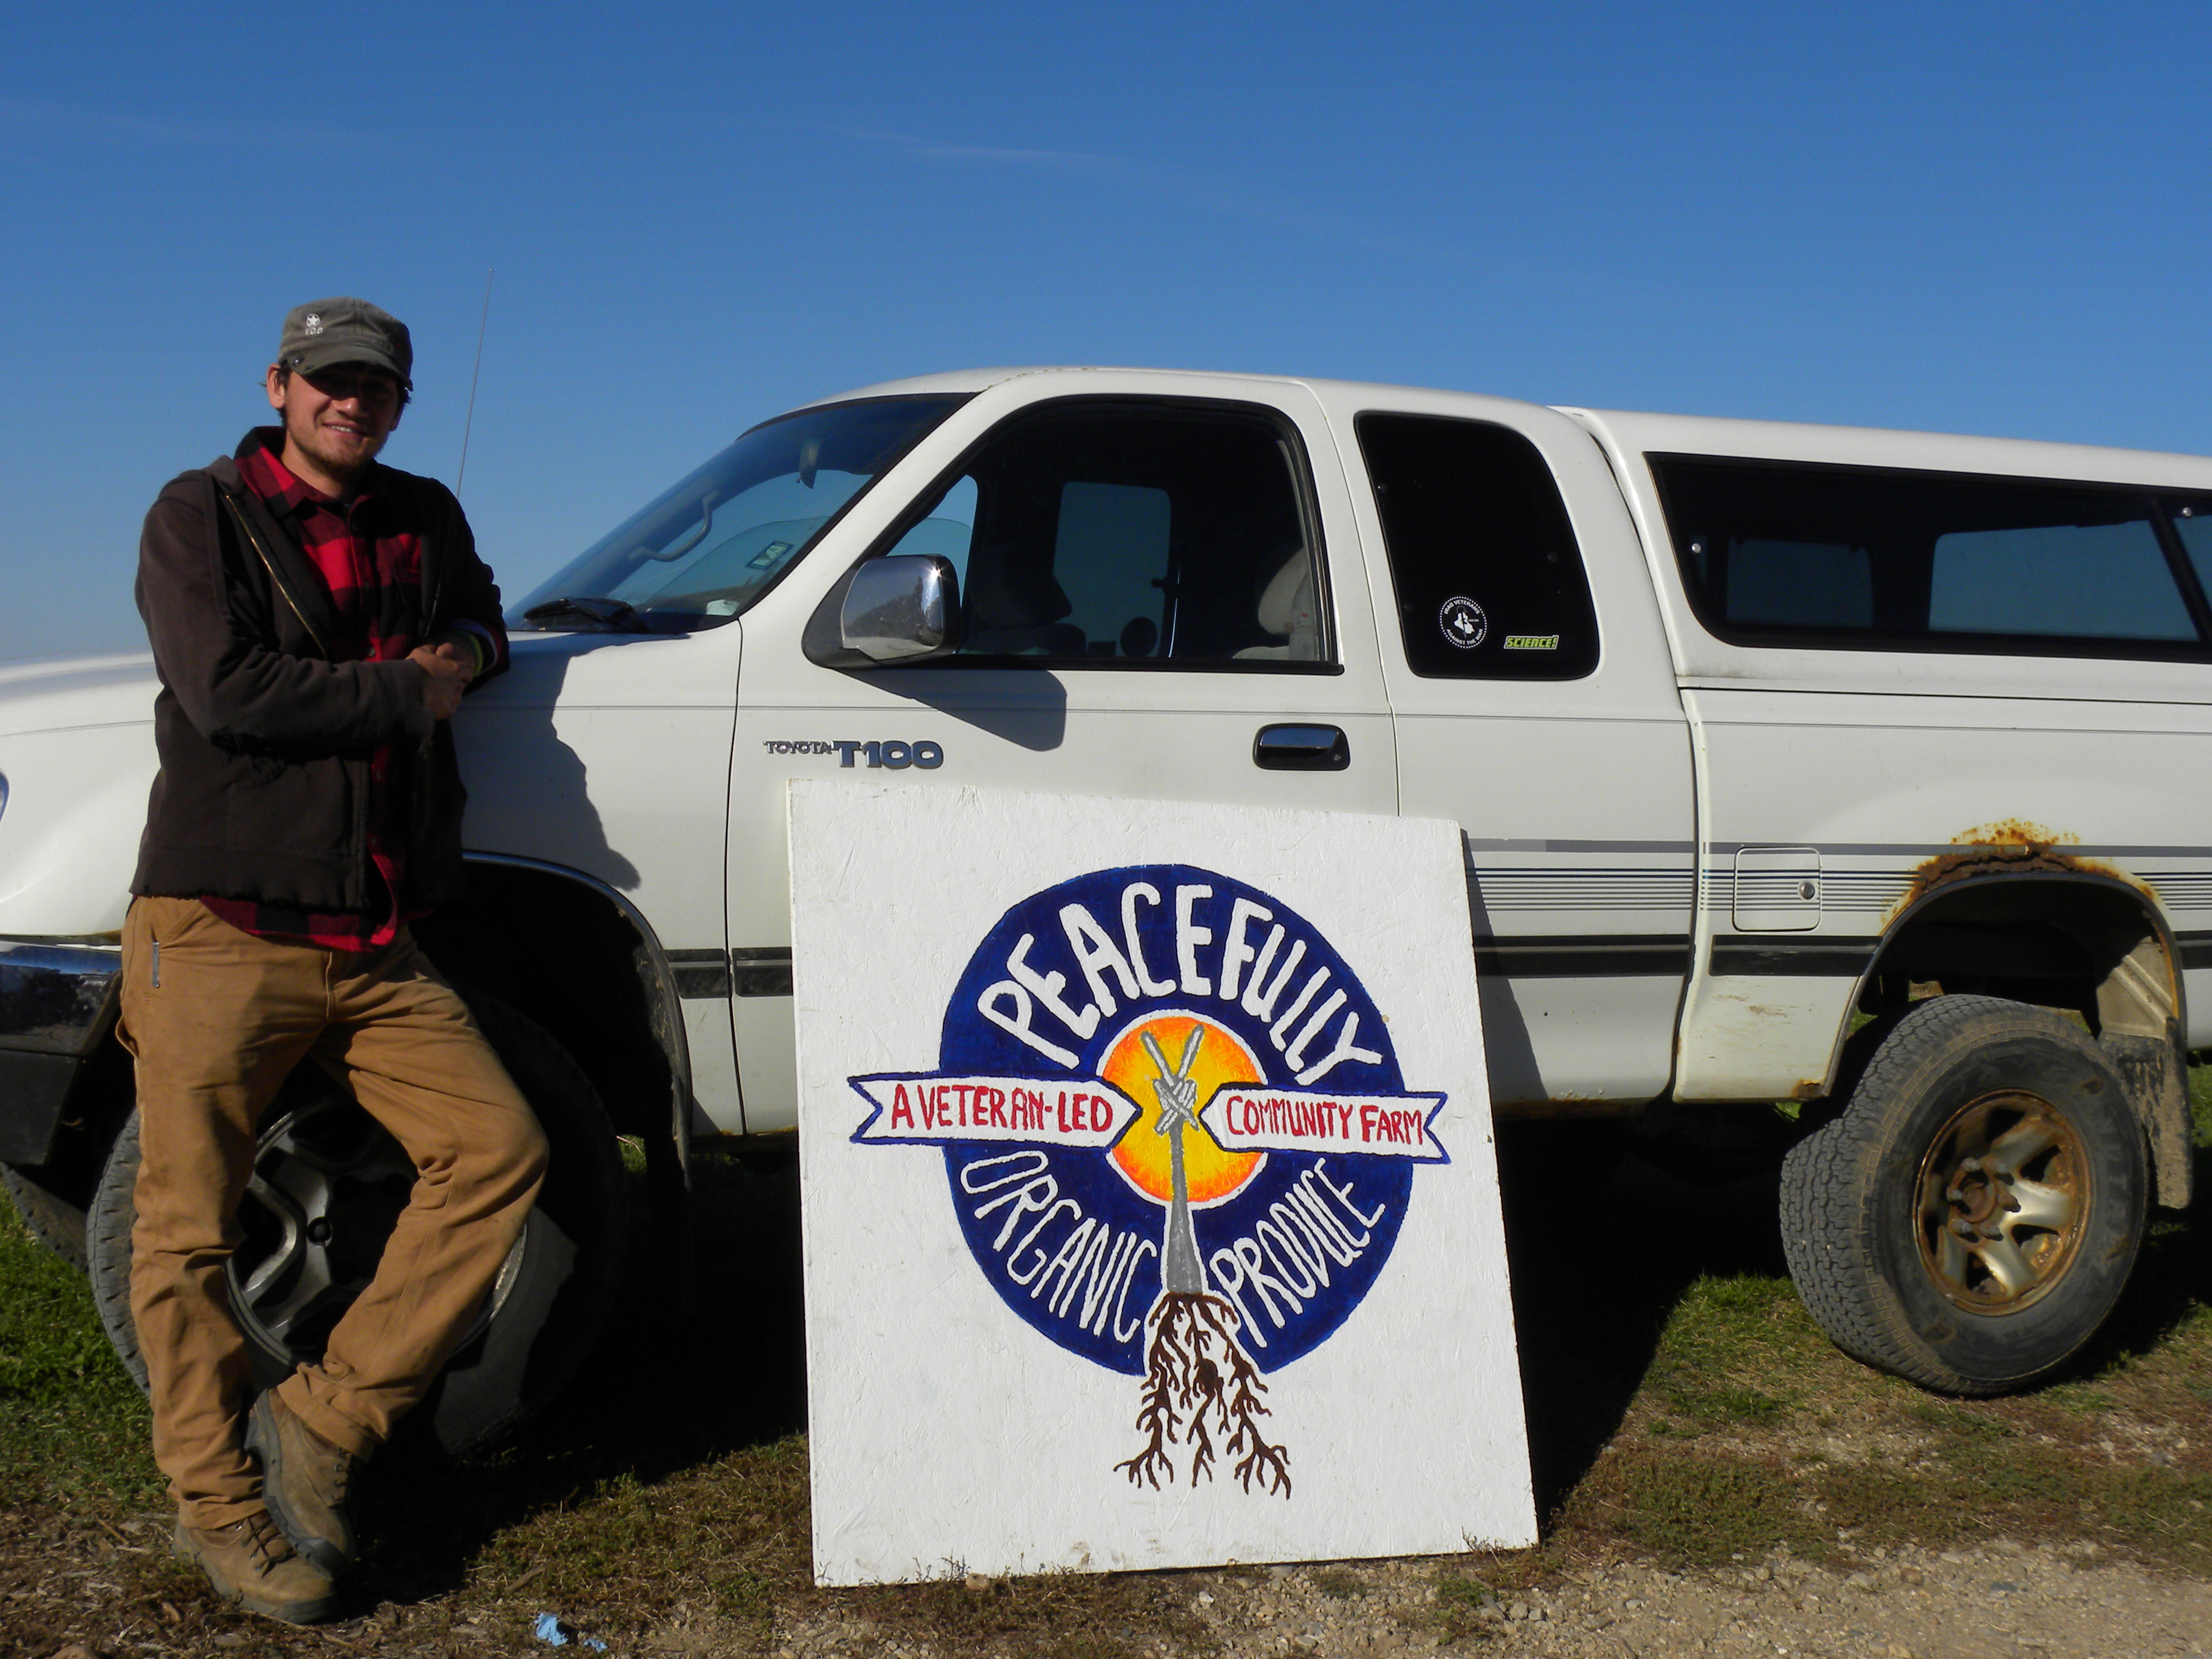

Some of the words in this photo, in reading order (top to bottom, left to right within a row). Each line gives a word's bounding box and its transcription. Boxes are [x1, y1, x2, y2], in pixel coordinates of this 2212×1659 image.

[1453, 599, 1480, 615] VETERANS
[1446, 629, 1465, 645] AGAINST
[1505, 636, 1558, 648] SCIENCE!
[763, 740, 833, 754] TOYOTA
[831, 740, 944, 769] T100
[977, 881, 1383, 1087] PEACEFULLY
[891, 1083, 914, 1130] A
[917, 1084, 1113, 1133] VETERAN-LED
[1227, 1095, 1353, 1139] COMMUNITY
[1359, 1105, 1423, 1145] FARM
[960, 1150, 1157, 1343] ORGANIC
[1209, 1157, 1386, 1348] PRODUCE
